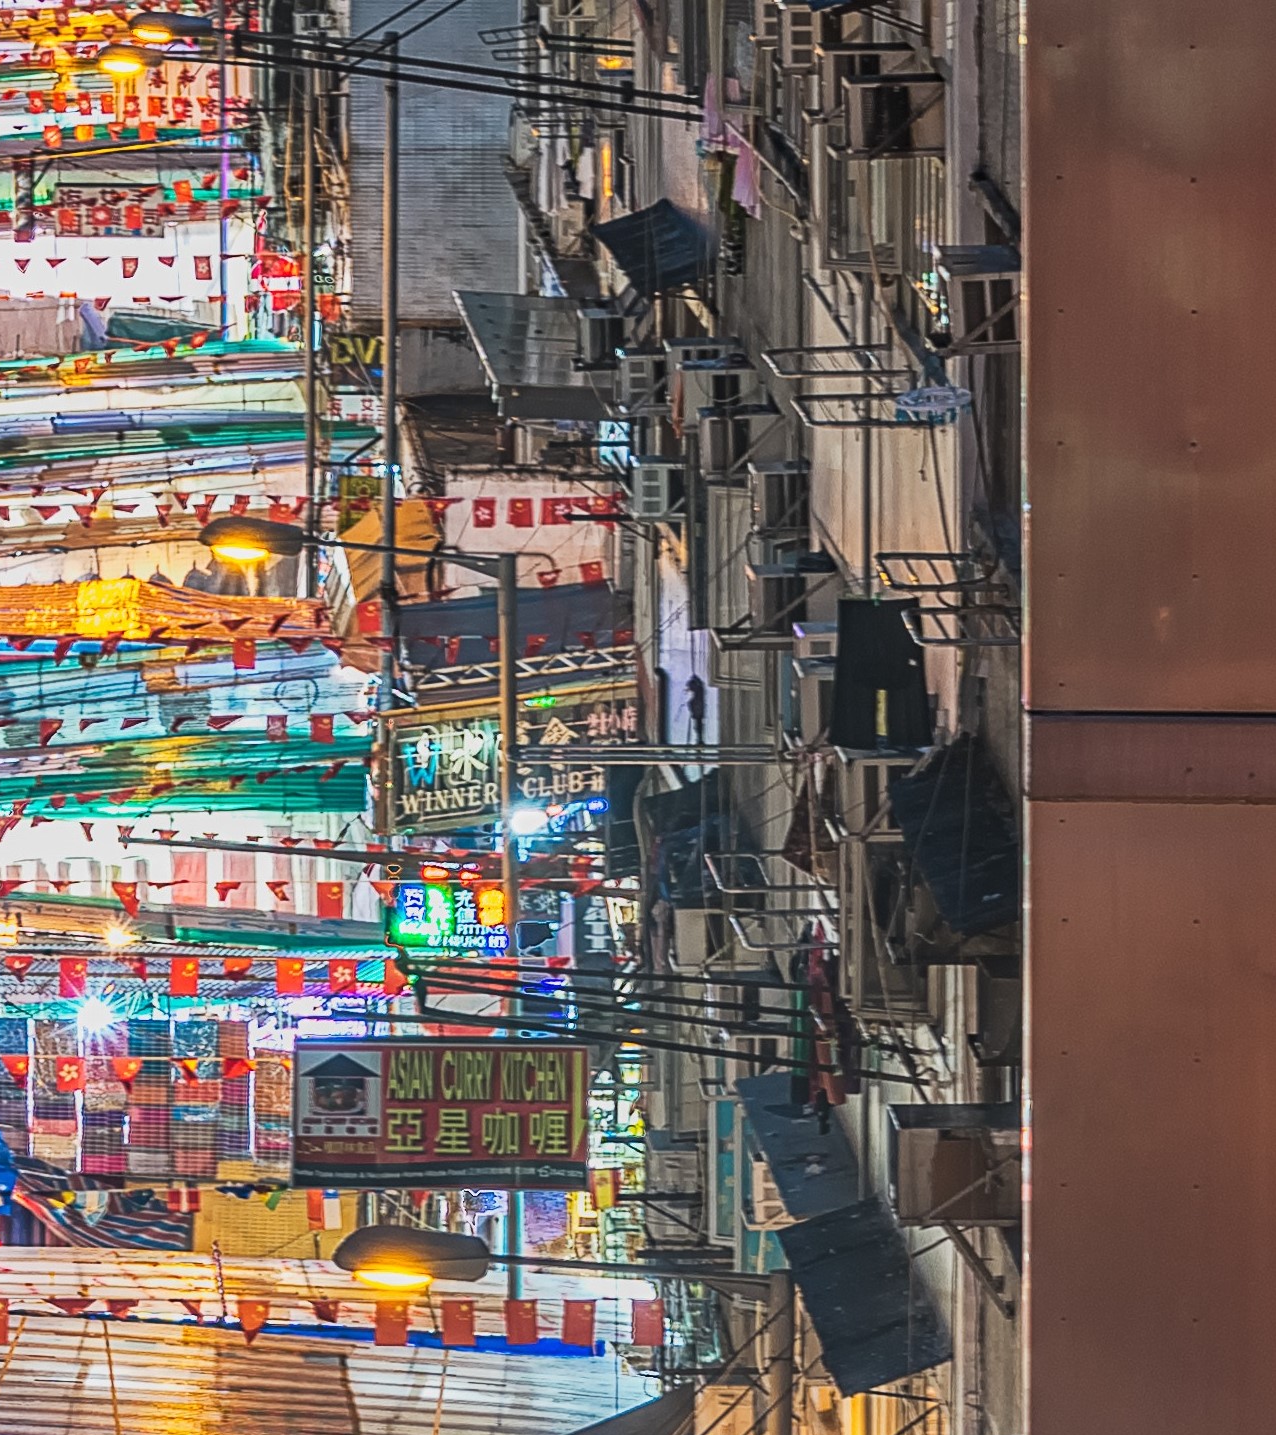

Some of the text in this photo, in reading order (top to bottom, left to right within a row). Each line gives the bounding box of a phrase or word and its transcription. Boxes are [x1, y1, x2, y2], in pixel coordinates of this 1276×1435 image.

[400, 782, 499, 815] WINNER
[522, 770, 583, 799] CLUB
[386, 1050, 568, 1101] ASIAN CURRY KITCHEN
[385, 1107, 570, 1155] 亞星咖喱
